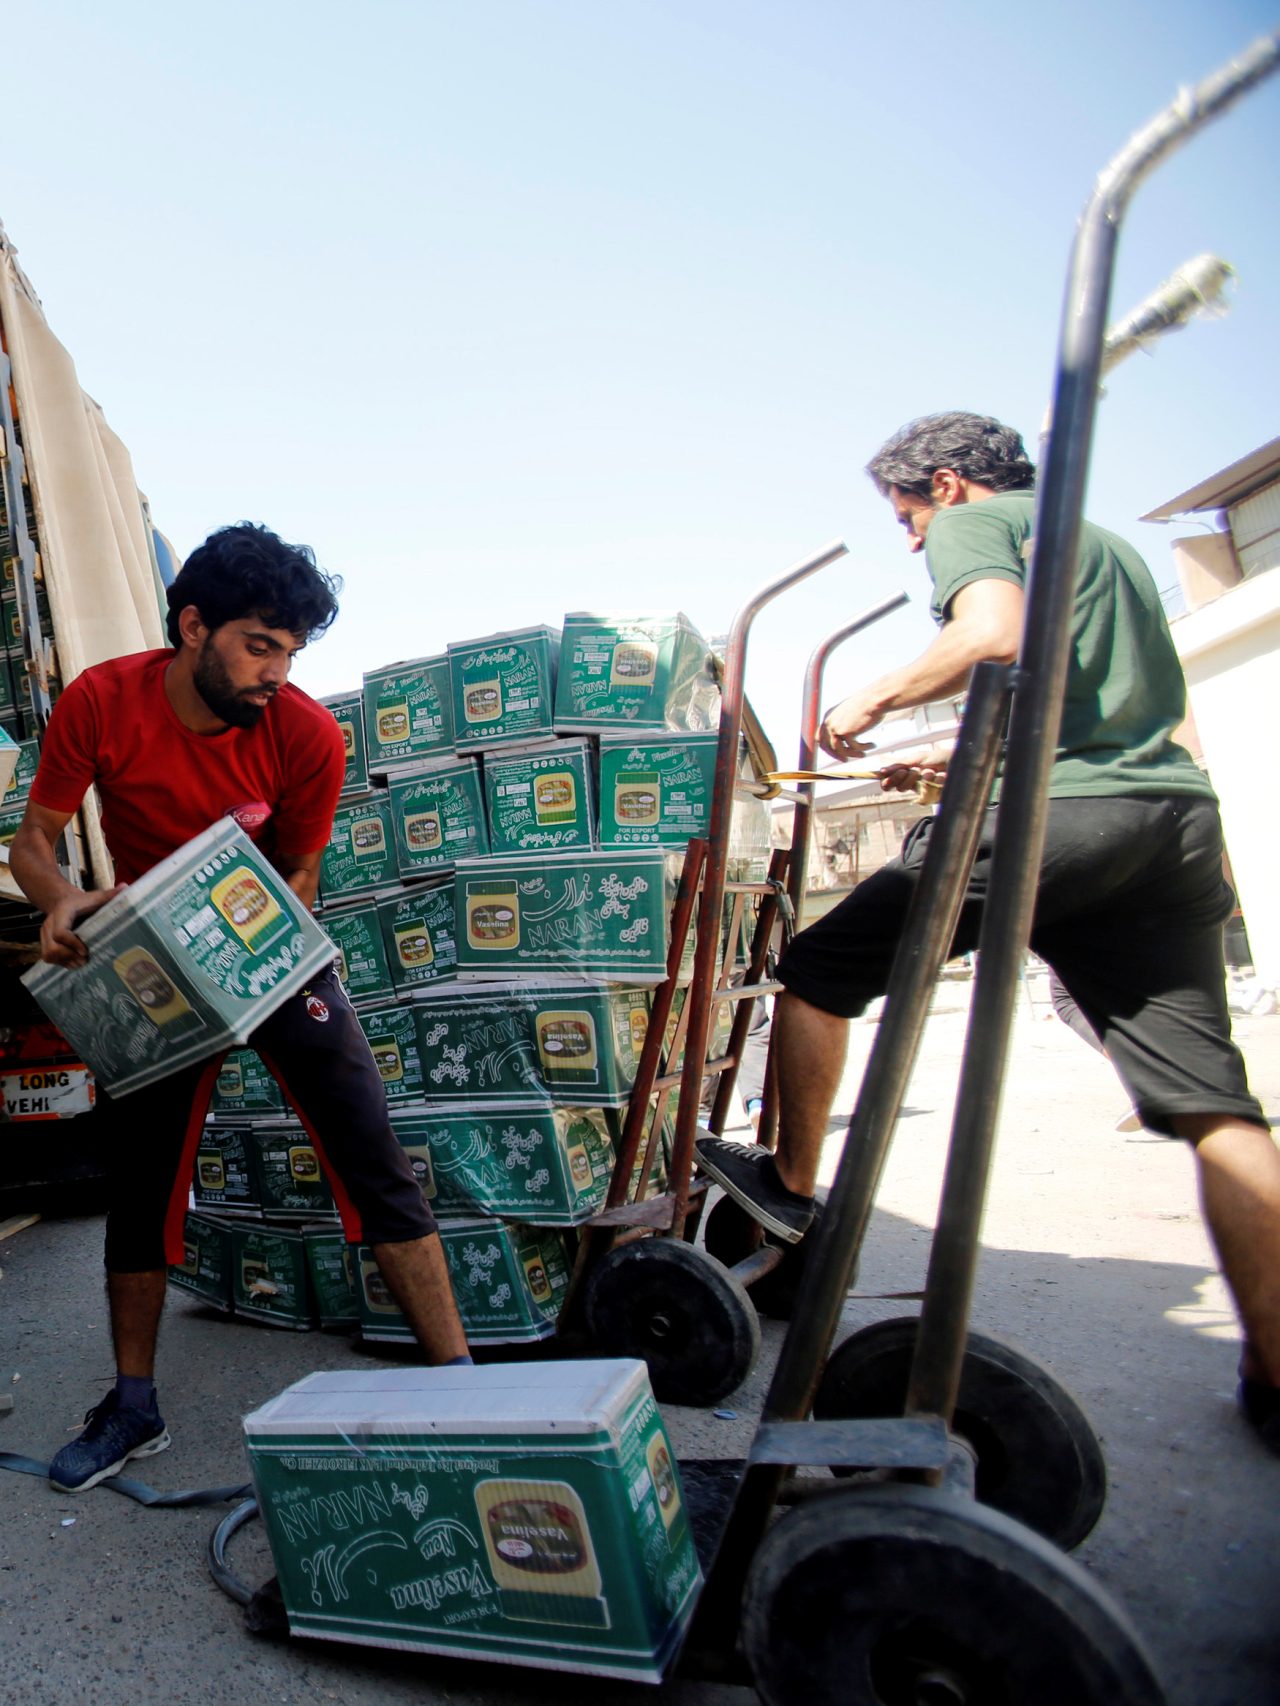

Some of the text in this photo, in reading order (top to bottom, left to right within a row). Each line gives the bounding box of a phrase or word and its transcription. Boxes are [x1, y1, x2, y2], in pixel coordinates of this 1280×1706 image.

[504, 666, 536, 687] NARAN
[409, 686, 437, 706] NARAN
[571, 680, 607, 696] NARAN
[663, 768, 702, 787] NARAN
[442, 797, 471, 817] NARAN
[500, 808, 532, 827] NARAN
[328, 855, 353, 874] NARAN
[427, 906, 455, 928] NARAN
[477, 920, 509, 928] Vaselina
[528, 909, 603, 948] NARAN
[344, 930, 369, 950] NARAN
[416, 964, 433, 973] EXPORT
[462, 1013, 529, 1053] NARAN
[19, 1072, 69, 1090] LONG
[455, 1459, 500, 1474] Product
[277, 1481, 392, 1543] NARAN
[501, 1524, 568, 1541] Vaselina
[420, 1528, 456, 1560] New
[390, 1560, 492, 1610] Vaselina
